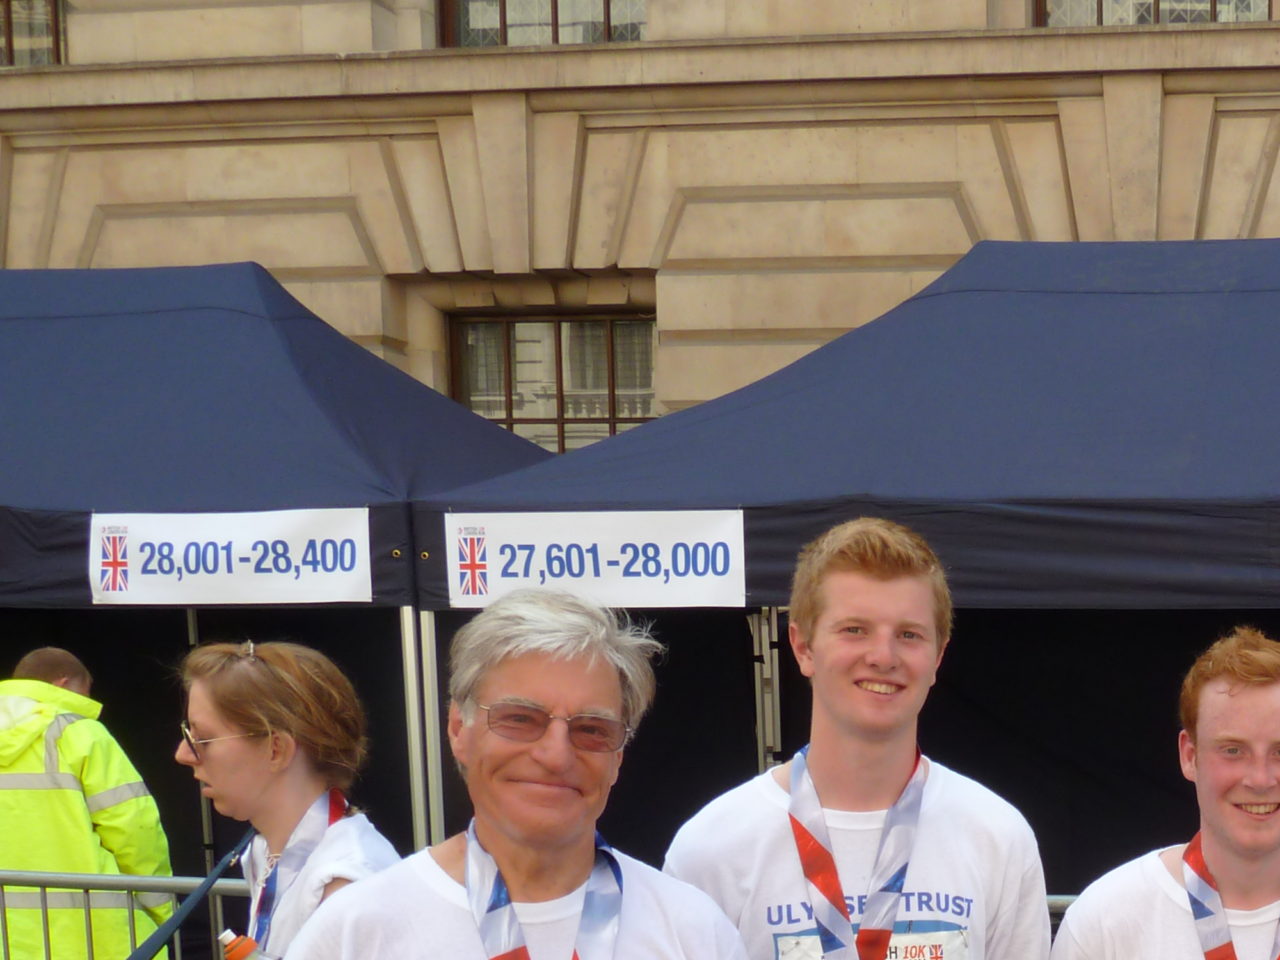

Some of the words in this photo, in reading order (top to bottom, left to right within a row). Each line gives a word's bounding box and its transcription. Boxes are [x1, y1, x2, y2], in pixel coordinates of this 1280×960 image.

[139, 538, 356, 581] 28,001-28,400
[499, 541, 730, 584] 27,601-28,000
[901, 891, 973, 919] TRUST
[903, 945, 926, 959] 10K
